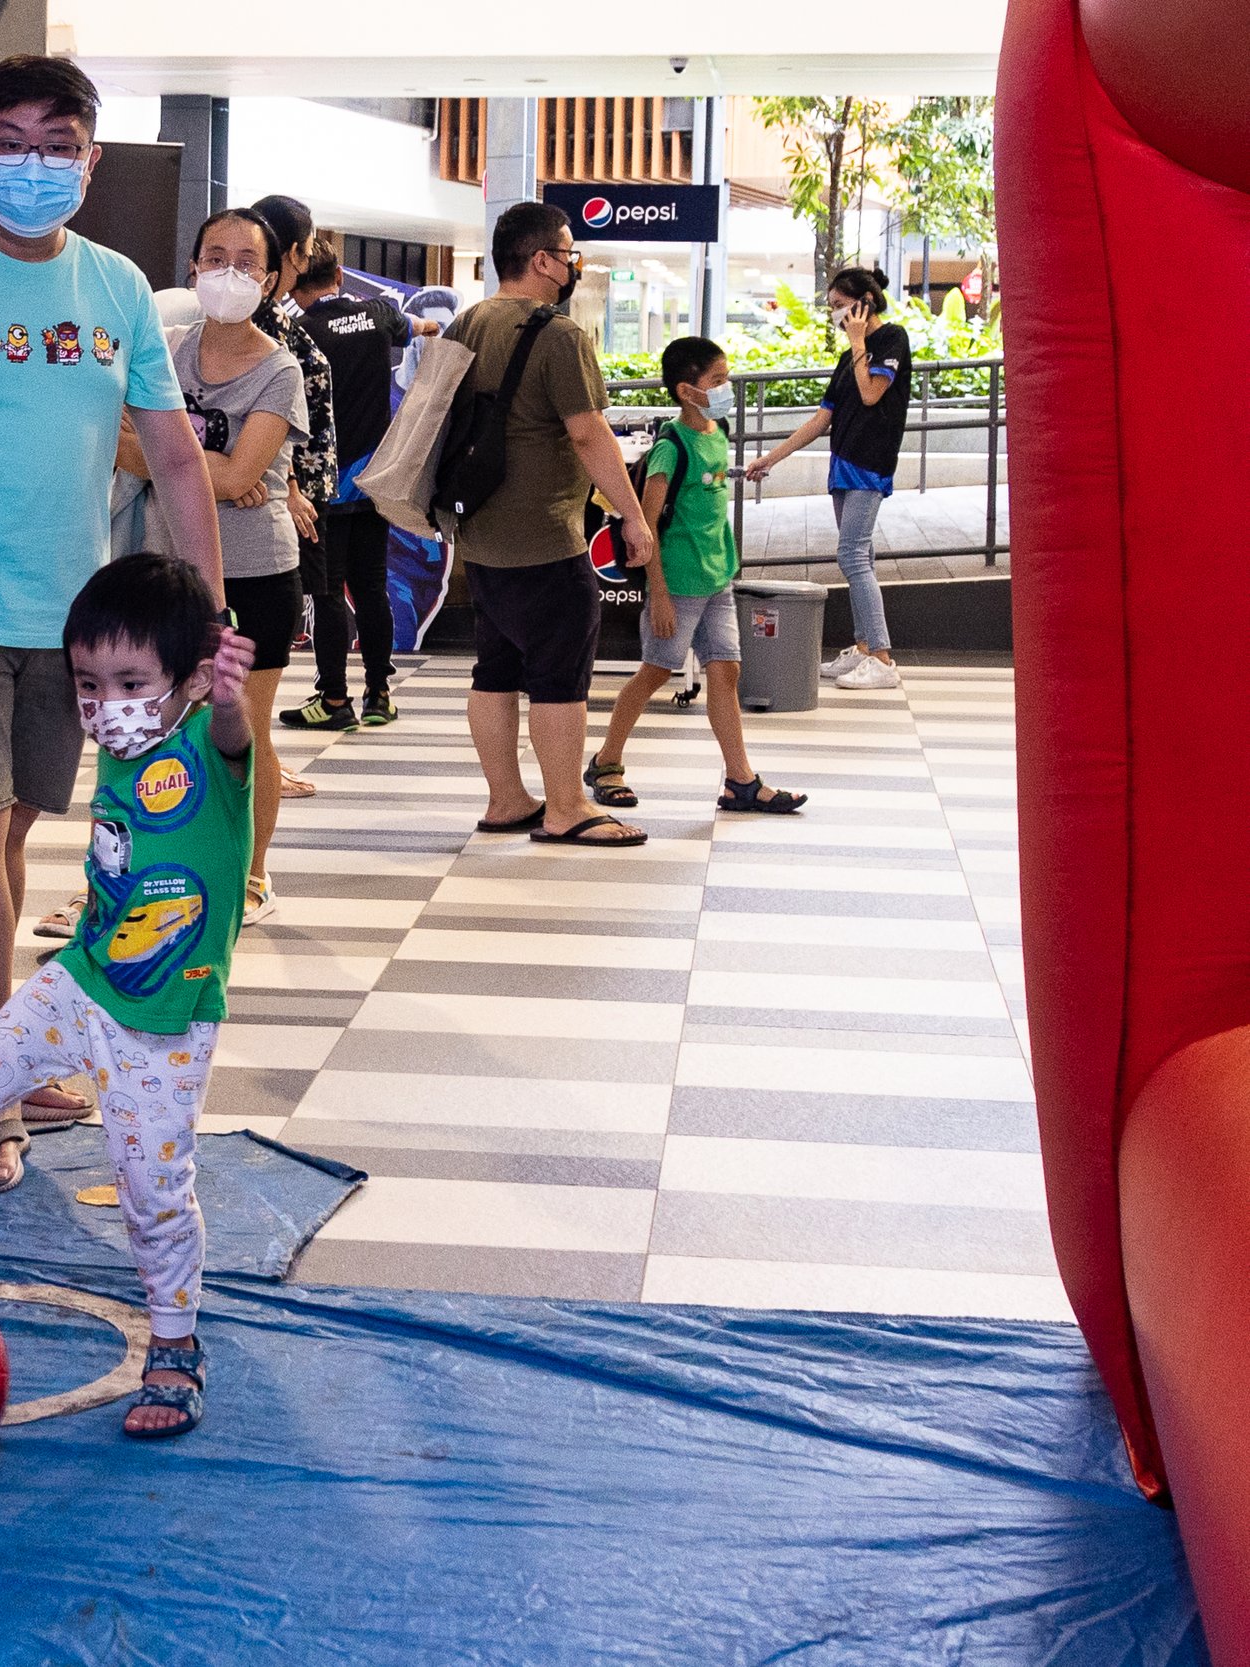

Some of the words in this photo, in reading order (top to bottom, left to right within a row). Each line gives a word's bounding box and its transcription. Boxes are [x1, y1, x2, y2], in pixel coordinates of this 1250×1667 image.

[616, 203, 676, 225] pepsi
[328, 316, 348, 329] PEPSI
[349, 311, 367, 323] PLAY
[339, 318, 376, 335] INSPIRE
[143, 887, 170, 896] CLASS
